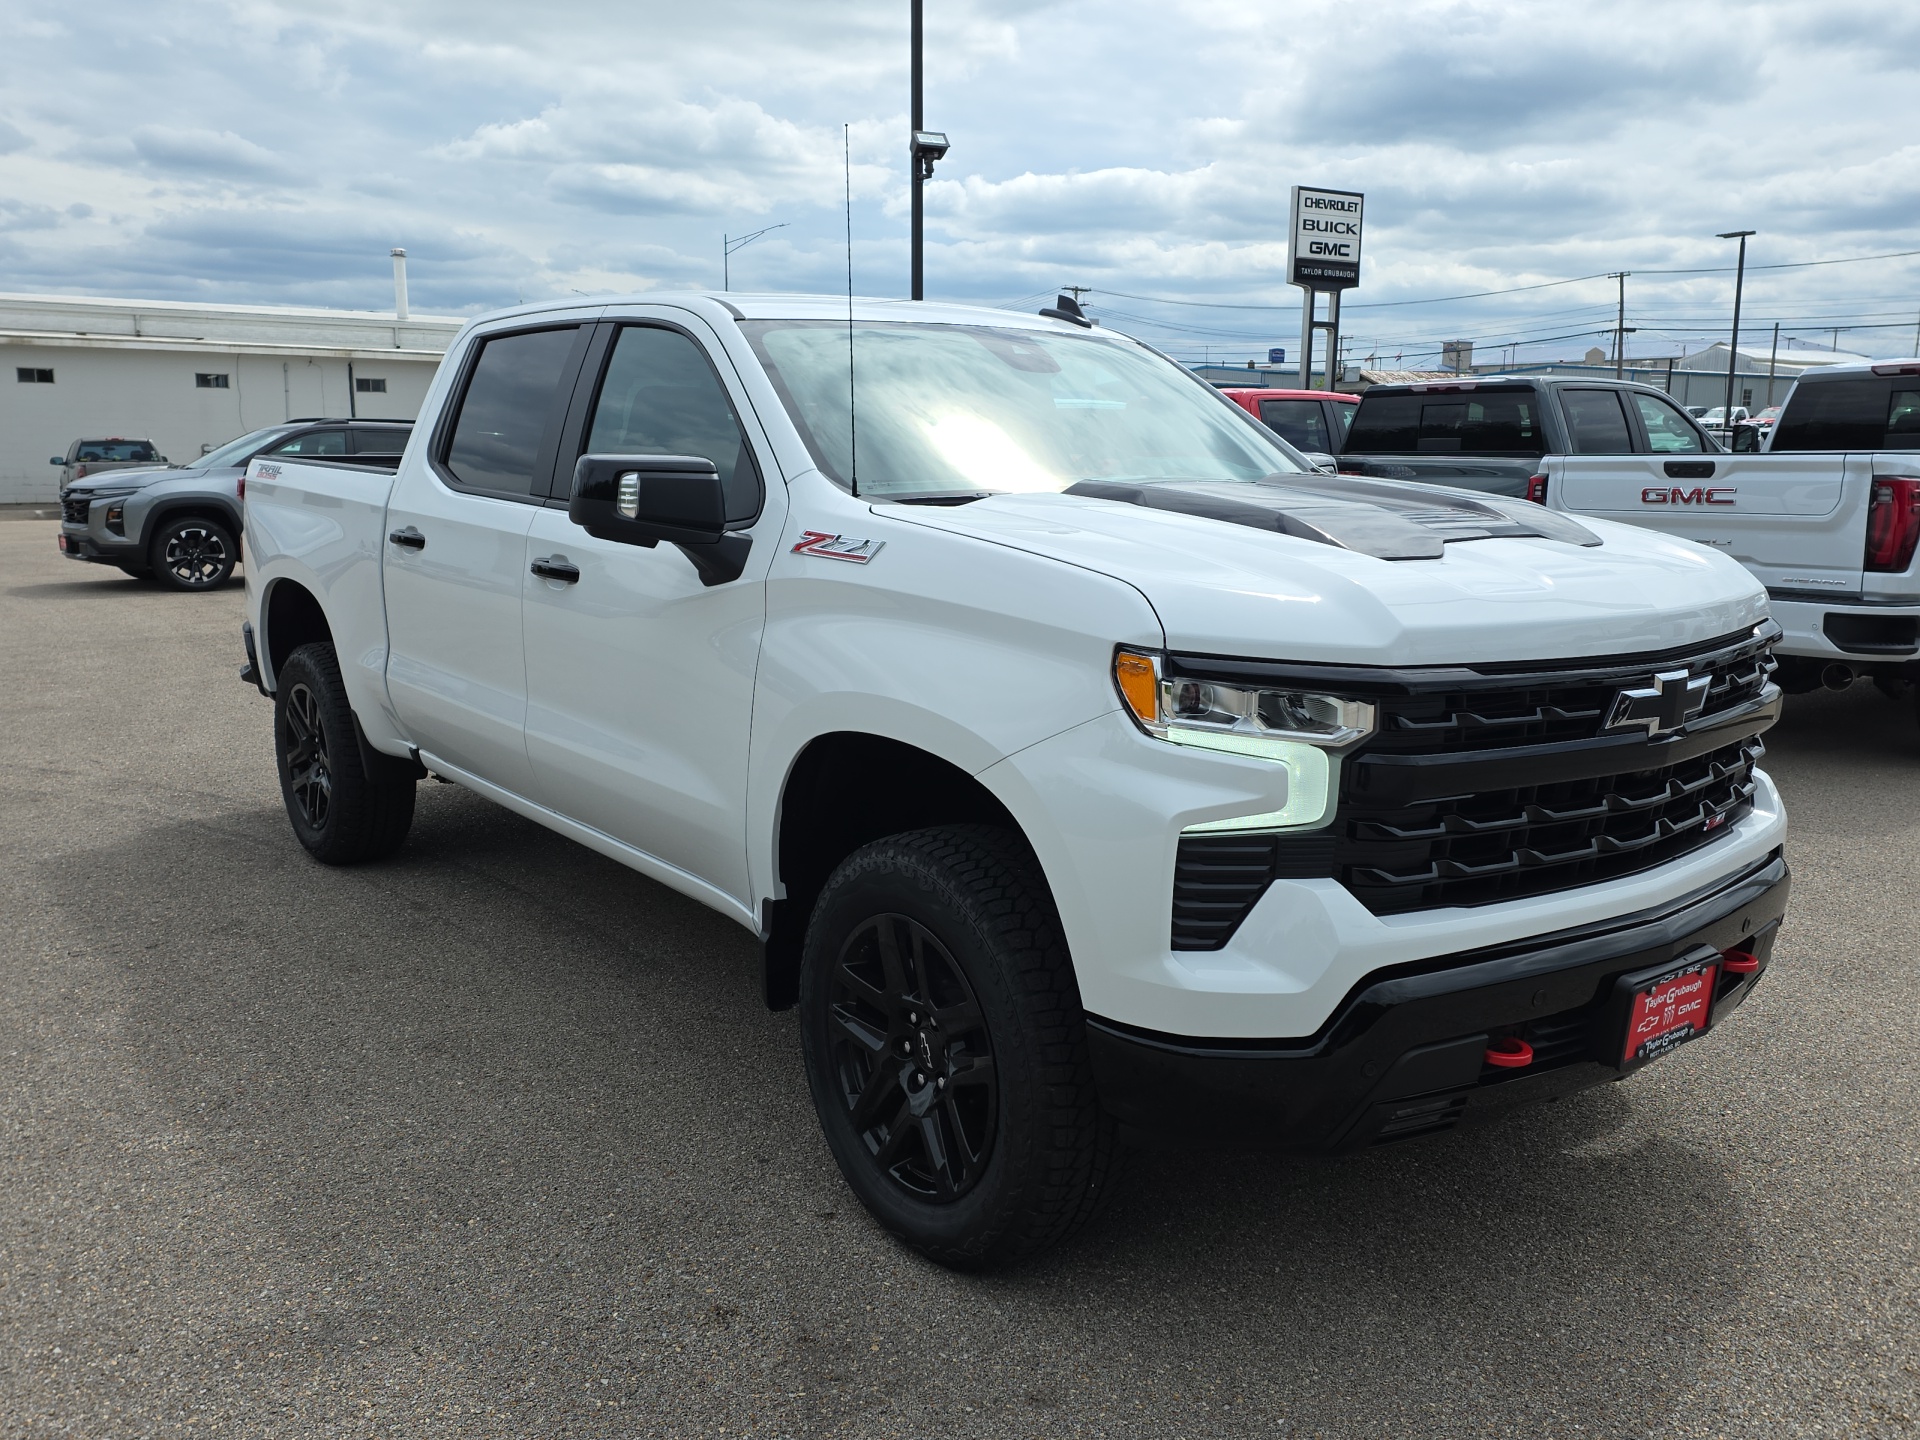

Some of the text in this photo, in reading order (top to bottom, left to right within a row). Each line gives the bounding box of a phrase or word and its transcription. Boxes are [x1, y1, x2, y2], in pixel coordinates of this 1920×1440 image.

[1304, 197, 1359, 213] CHEVROLET
[1302, 219, 1358, 235] BUICK
[1309, 241, 1350, 257] GMC
[1301, 267, 1355, 278] TAYLOR GRUBAUGH
[256, 472, 278, 480] BOSS
[258, 464, 282, 475] TRAIL
[1641, 486, 1737, 506] GMC
[790, 529, 886, 565] Z71
[1782, 577, 1847, 586] SIERRA
[1645, 979, 1702, 1013] Taylor Grubaugh
[1677, 998, 1702, 1015] GMC
